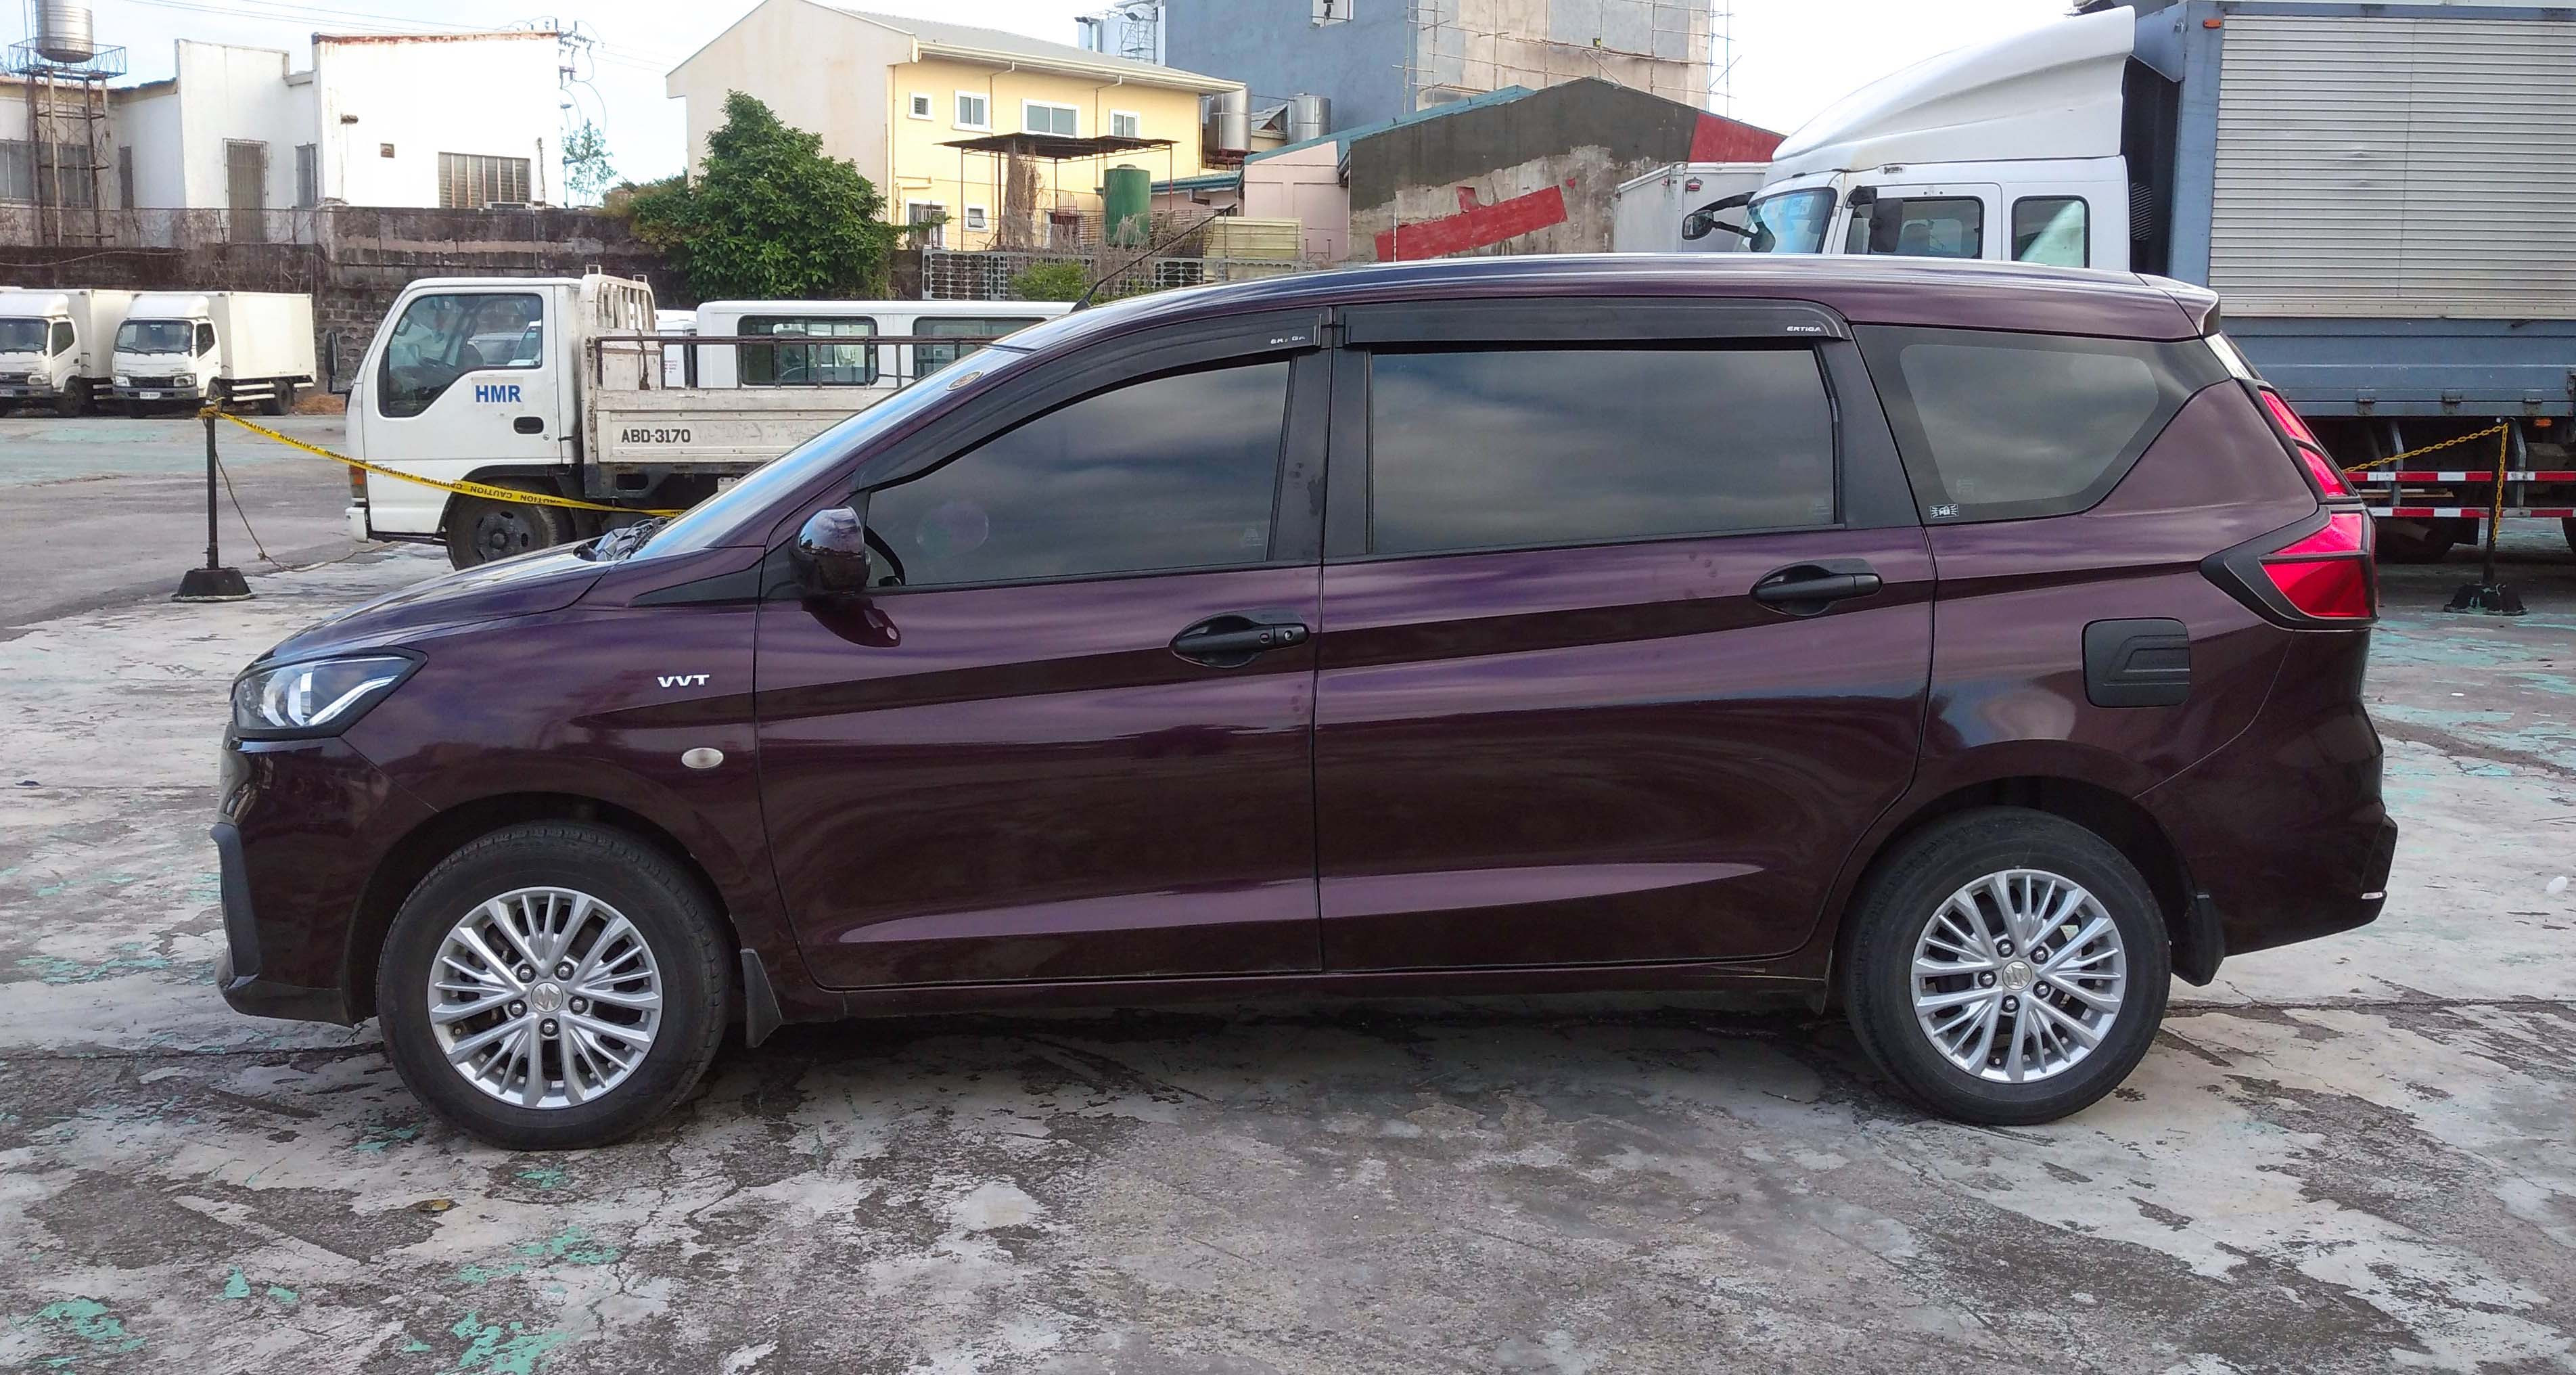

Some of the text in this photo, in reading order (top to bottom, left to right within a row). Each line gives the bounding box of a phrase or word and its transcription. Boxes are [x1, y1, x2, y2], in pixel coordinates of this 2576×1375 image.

[476, 384, 522, 403] HMR
[621, 428, 691, 443] ABD-3170
[469, 485, 513, 499] CAUTION
[657, 674, 710, 688] VVT
